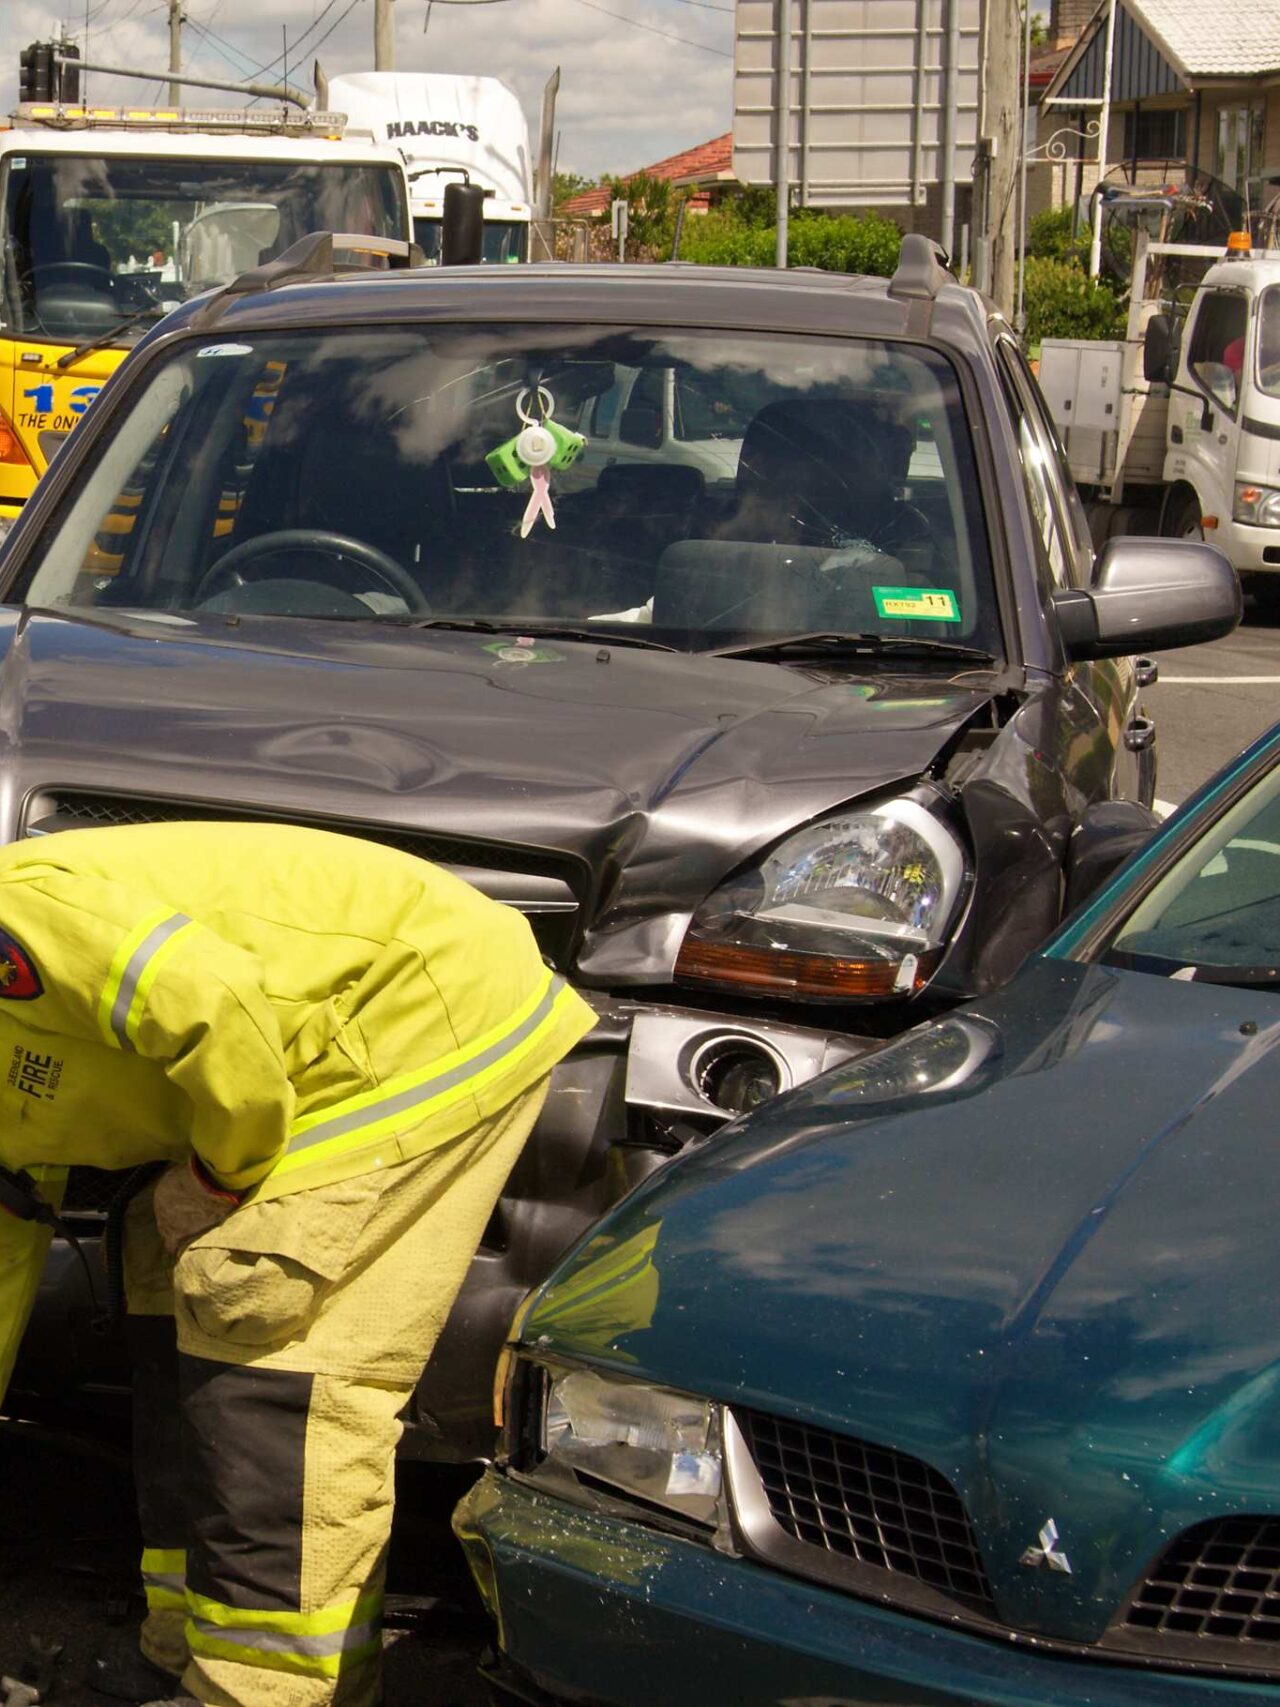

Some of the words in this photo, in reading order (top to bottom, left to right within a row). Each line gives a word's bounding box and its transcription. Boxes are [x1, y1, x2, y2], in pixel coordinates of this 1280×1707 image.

[386, 121, 479, 142] HAACK'S
[18, 413, 47, 428] THE
[53, 415, 80, 430] ON
[18, 1050, 52, 1099] FIRE
[48, 1060, 64, 1090] RESCUE
